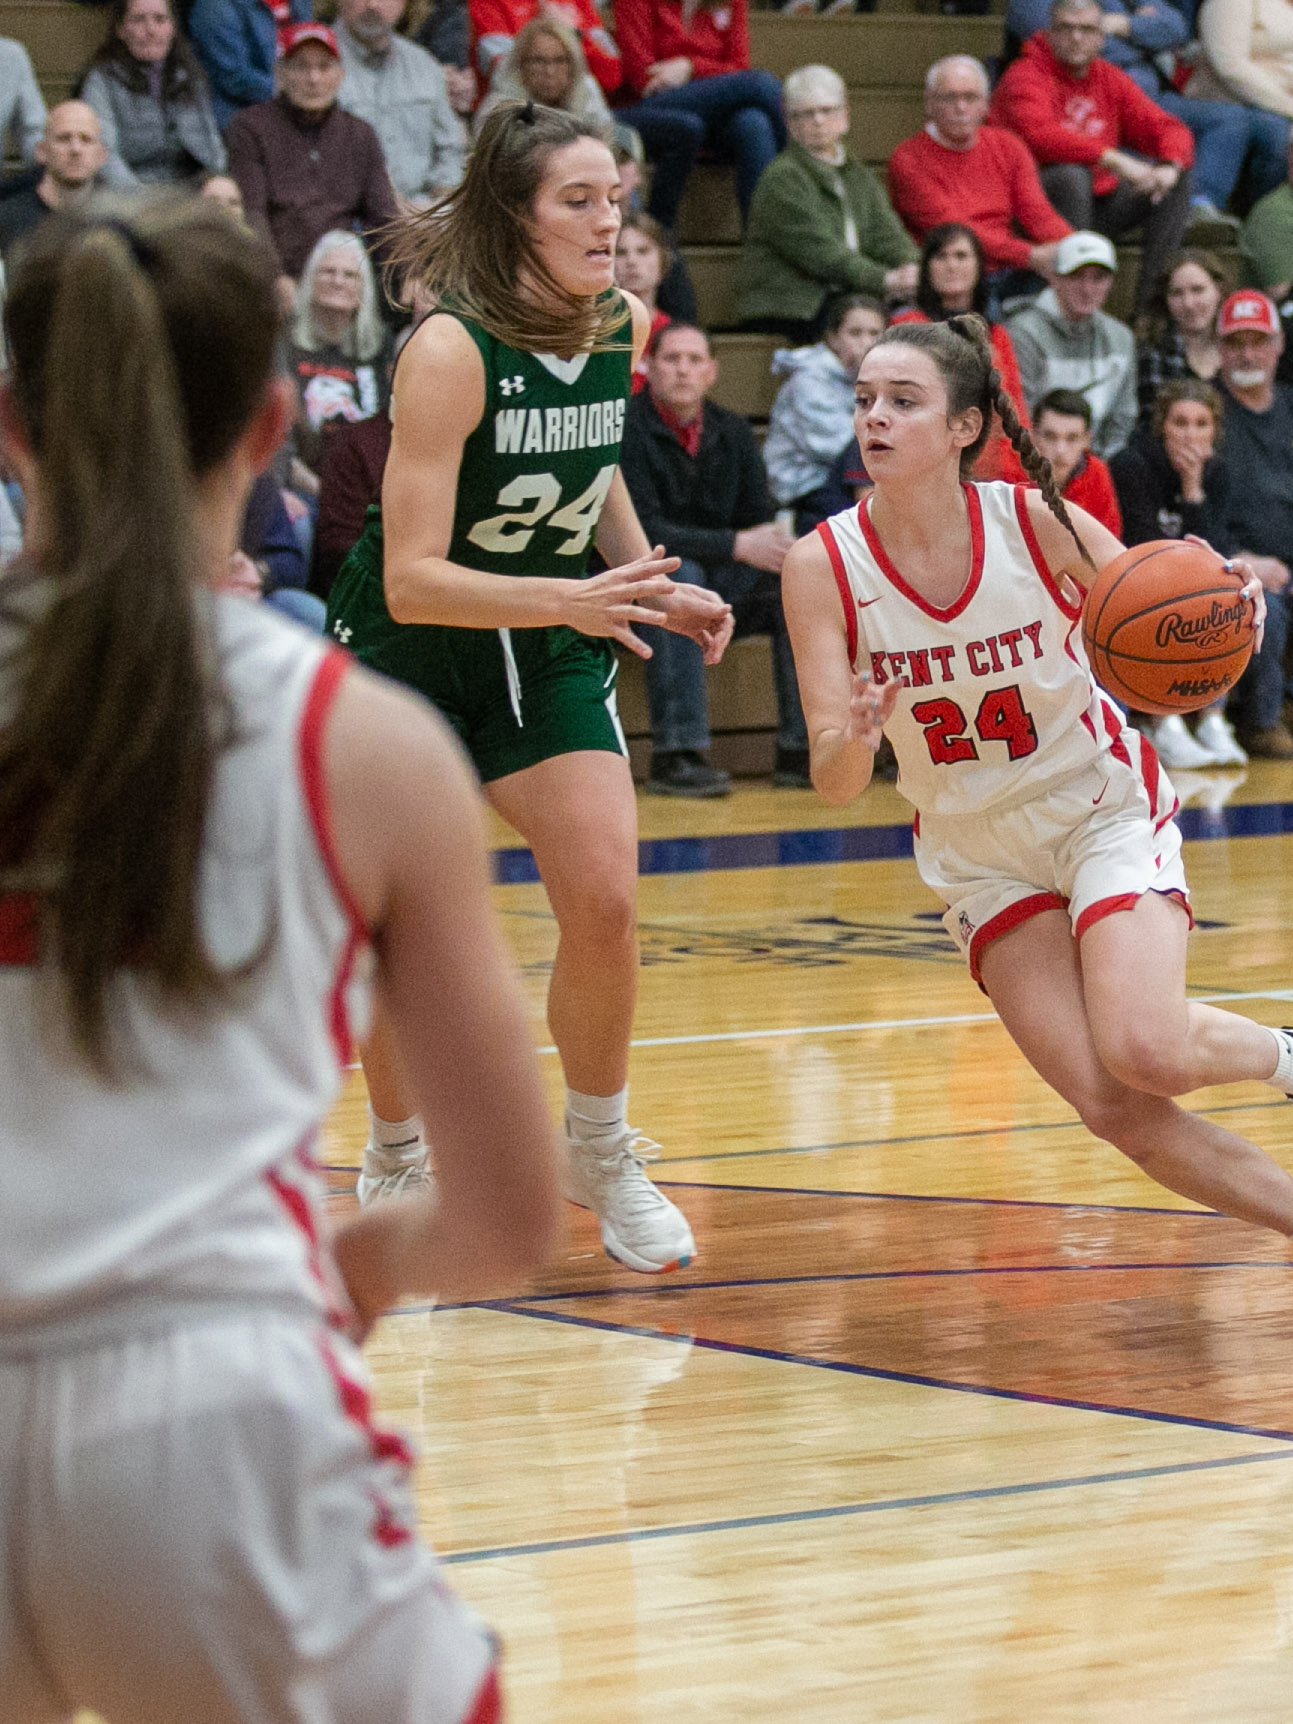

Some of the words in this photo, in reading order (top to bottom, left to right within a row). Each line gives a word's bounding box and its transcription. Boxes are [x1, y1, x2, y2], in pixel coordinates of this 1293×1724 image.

[495, 398, 626, 454] WARRIORS
[466, 463, 617, 556] 24
[870, 644, 956, 688] KENT
[965, 620, 1044, 677] CITY
[910, 684, 1039, 766] 24
